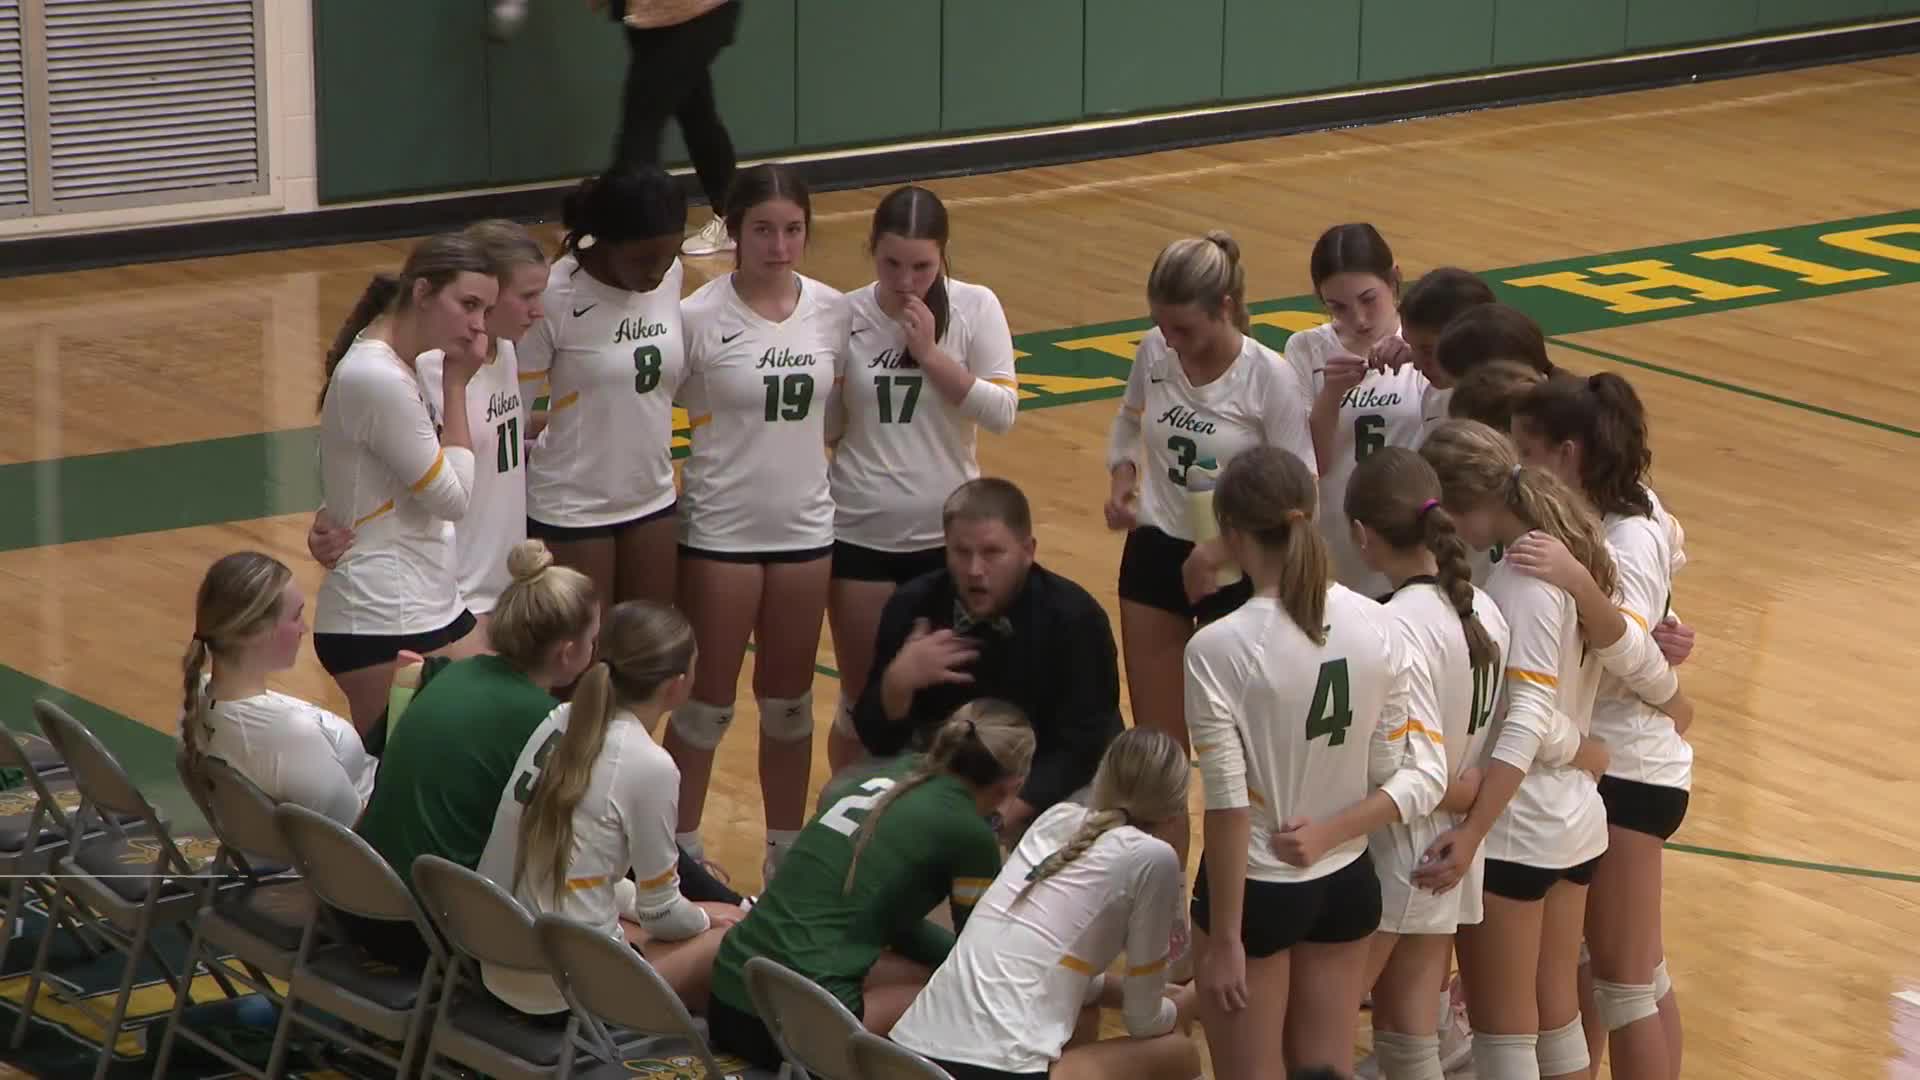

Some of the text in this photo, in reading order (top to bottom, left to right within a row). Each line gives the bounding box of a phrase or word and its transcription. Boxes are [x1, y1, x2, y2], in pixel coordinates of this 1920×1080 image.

[613, 317, 667, 344] Aiken
[633, 344, 661, 394] 8
[755, 346, 816, 369] Aiken
[486, 392, 519, 422] Aiken
[763, 373, 814, 422] 19
[874, 375, 922, 424] 17
[1157, 405, 1216, 435] Aiken
[1341, 387, 1400, 409] Aiken
[497, 417, 518, 473] 11
[1168, 435, 1197, 486] 3
[1355, 414, 1385, 461] 6
[1306, 657, 1352, 747] 4
[819, 777, 897, 837] 2
